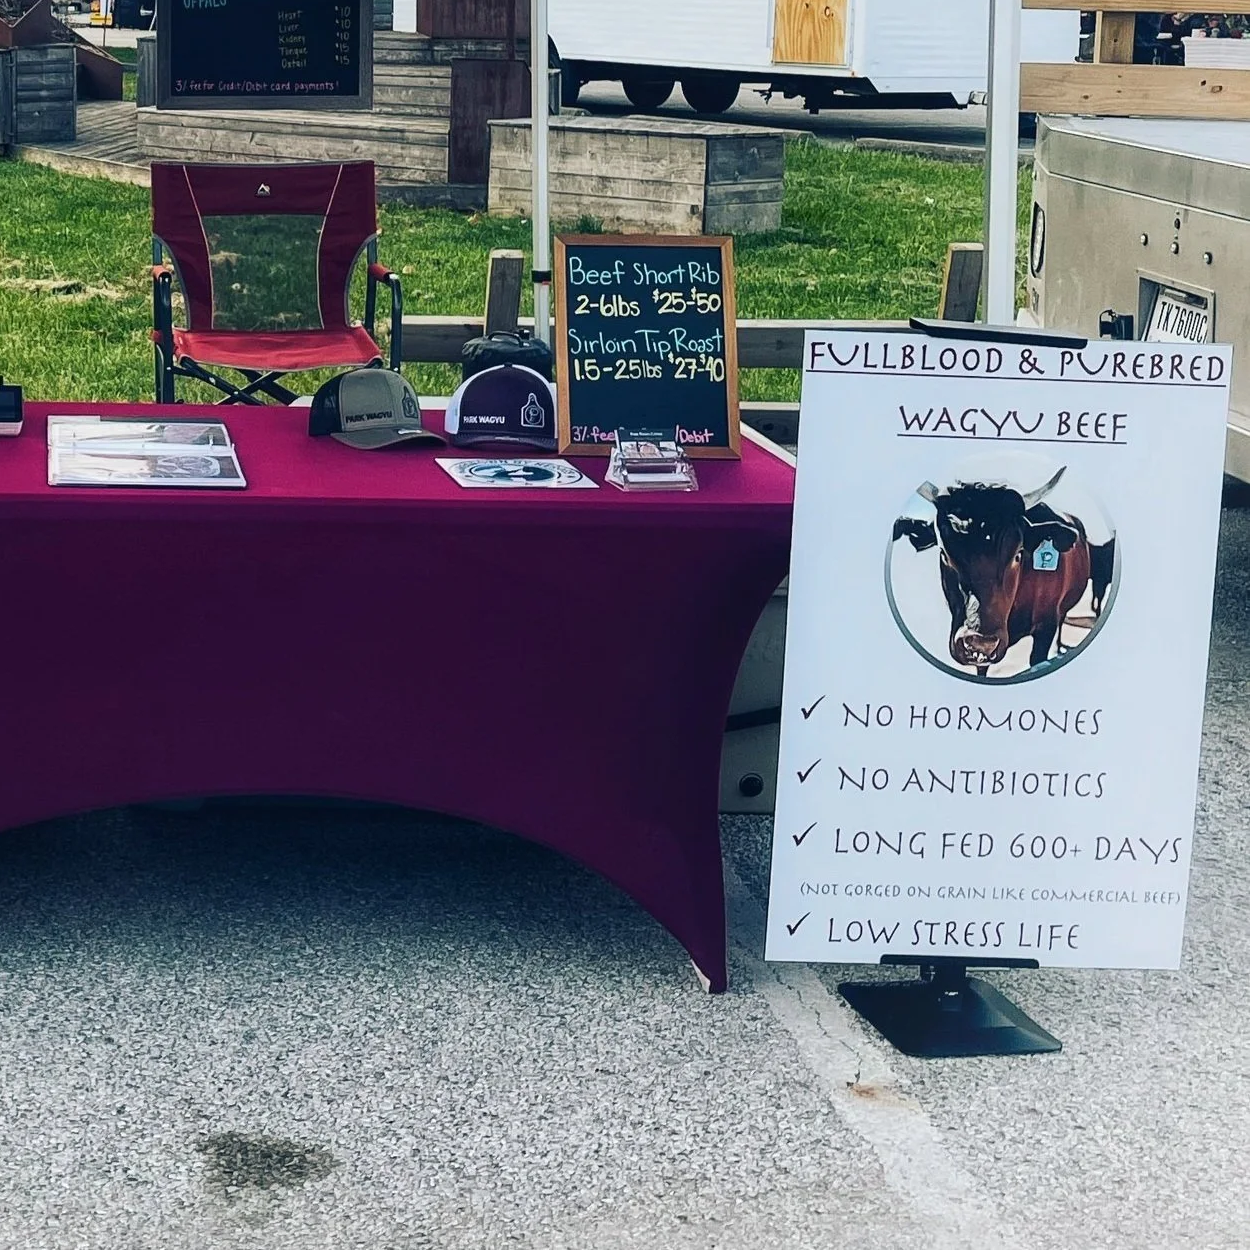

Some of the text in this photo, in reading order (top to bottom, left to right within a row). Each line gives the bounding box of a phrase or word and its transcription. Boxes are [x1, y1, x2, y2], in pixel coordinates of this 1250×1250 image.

[569, 257, 719, 285] Beef Short Rib
[569, 328, 723, 360] Sirloin Tip Roast
[809, 342, 1224, 381] FULLBLOOD & PUREBRED
[479, 416, 505, 424] WAGYU
[899, 406, 1128, 440] WAGYU BEEF
[843, 703, 1103, 734] NO HORMONES
[838, 767, 1106, 797] NO ANTIBIOTICS
[835, 828, 1182, 864] LONG FED 600+ DAYS
[800, 883, 1181, 904] (NOT GORGED ON GRAIN LIKE COMMERCIAL BEEF)
[828, 917, 1080, 950] LOW STRESS LIFE
